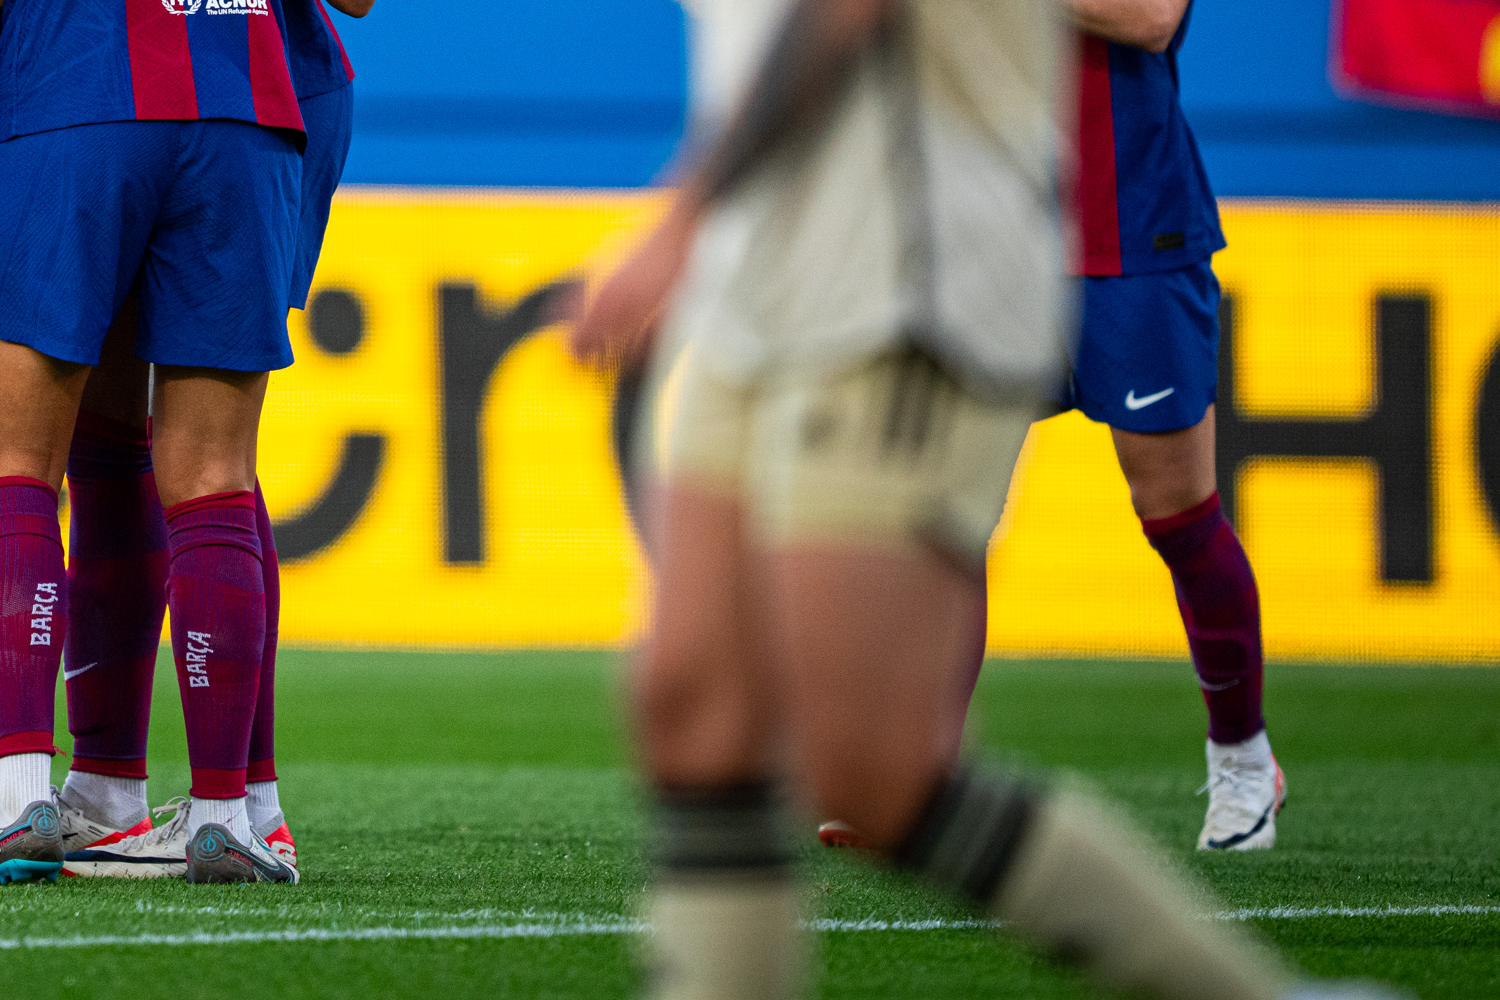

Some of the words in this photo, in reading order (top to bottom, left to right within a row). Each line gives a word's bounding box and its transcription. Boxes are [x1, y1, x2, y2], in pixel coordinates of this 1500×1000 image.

[228, 8, 252, 16] Refugee
[29, 582, 59, 646] BARÇA
[185, 624, 214, 688] BARÇA
